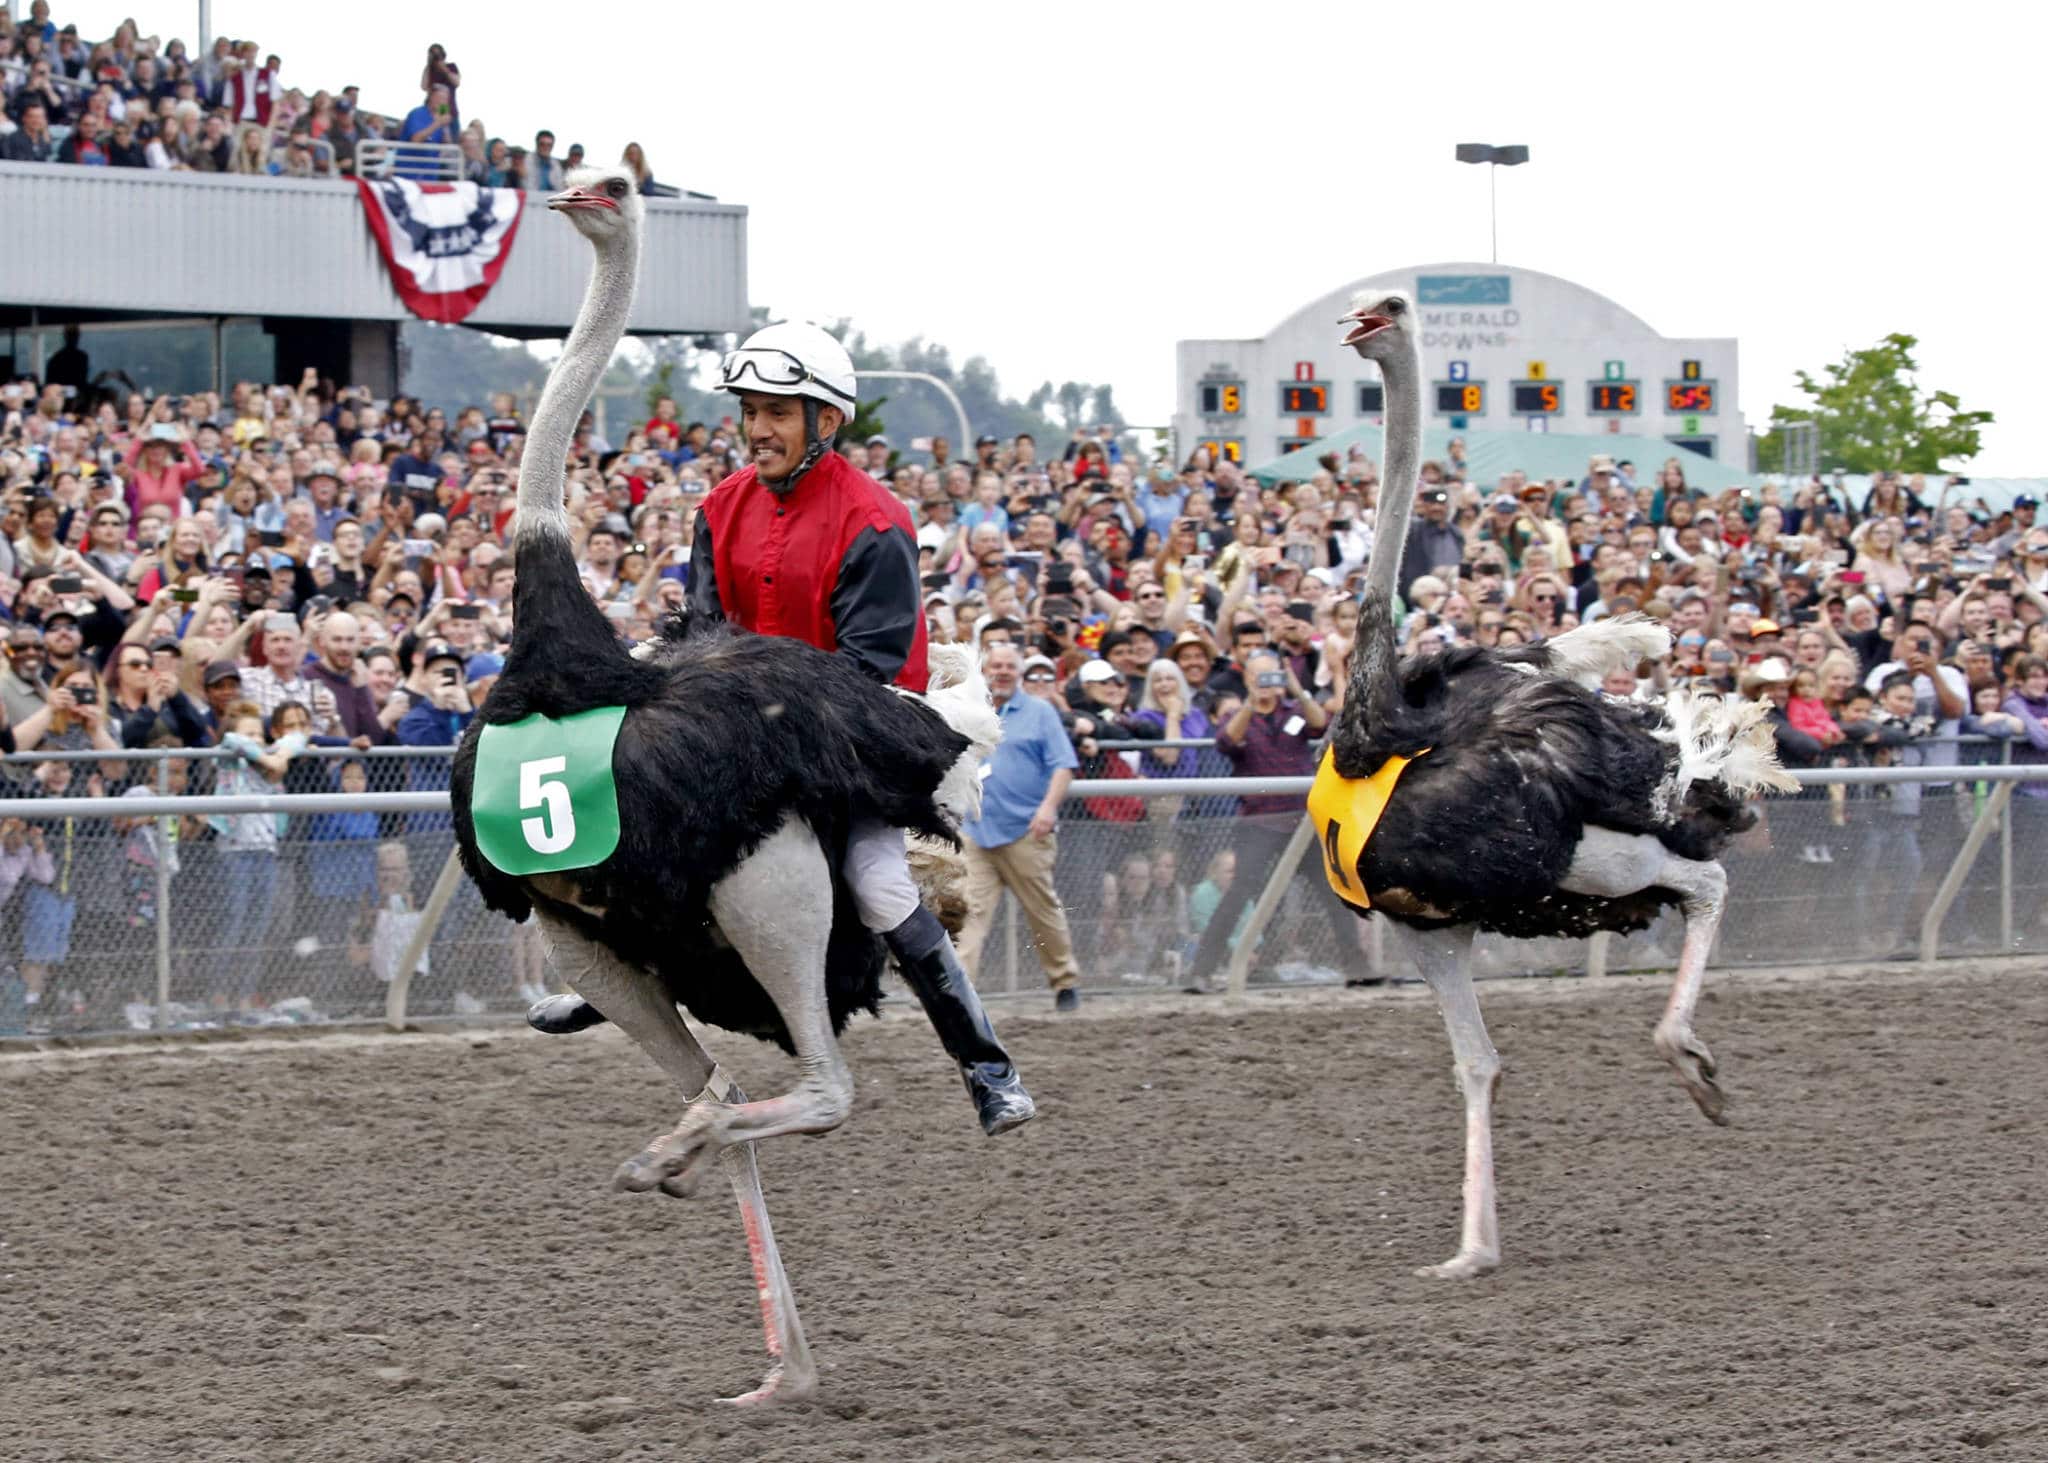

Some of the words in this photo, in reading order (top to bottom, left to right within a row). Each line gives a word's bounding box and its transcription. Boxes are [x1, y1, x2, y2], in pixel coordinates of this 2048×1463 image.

[1420, 309, 1519, 327] MERALD
[1450, 362, 1466, 381] 3
[1222, 385, 1239, 413] 6
[1462, 384, 1481, 412] 8
[1540, 385, 1559, 411] 5
[519, 755, 576, 855] 5
